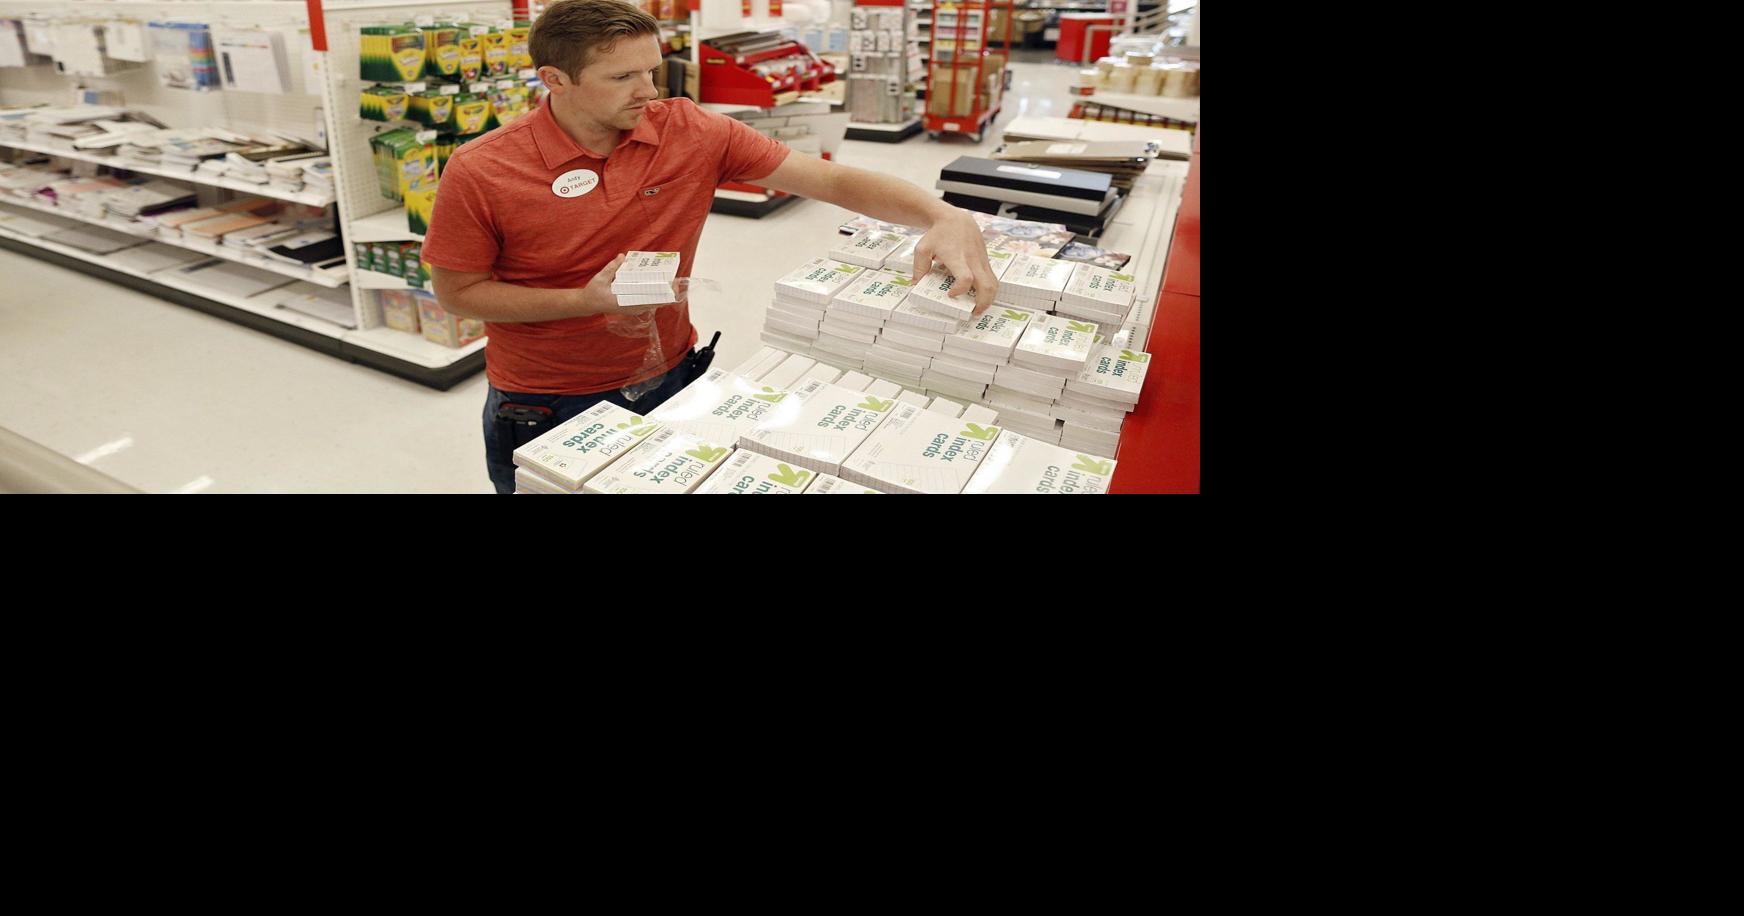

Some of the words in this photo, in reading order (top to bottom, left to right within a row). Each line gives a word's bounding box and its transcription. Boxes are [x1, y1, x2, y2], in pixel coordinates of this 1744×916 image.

[570, 178, 595, 189] TARGET
[805, 267, 826, 280] cards
[939, 275, 956, 292] cards
[863, 281, 882, 295] cards
[976, 314, 993, 331] cards
[989, 318, 1010, 332] index
[1044, 326, 1059, 344] cards
[1058, 330, 1077, 346] index
[1096, 356, 1111, 374] cards
[1112, 360, 1131, 377] index
[712, 394, 742, 416] cards
[726, 398, 761, 420] index
[746, 401, 772, 421] ruled
[817, 404, 846, 428] cards
[833, 408, 866, 431] index
[854, 411, 879, 431] ruled
[562, 423, 604, 447] cards
[599, 435, 633, 457] ruled
[922, 433, 949, 458] cards
[940, 436, 971, 462] index
[963, 440, 985, 462] ruled
[650, 455, 693, 484] index
[674, 461, 706, 487] ruled
[1036, 465, 1060, 494] cards
[1081, 475, 1102, 494] rule
